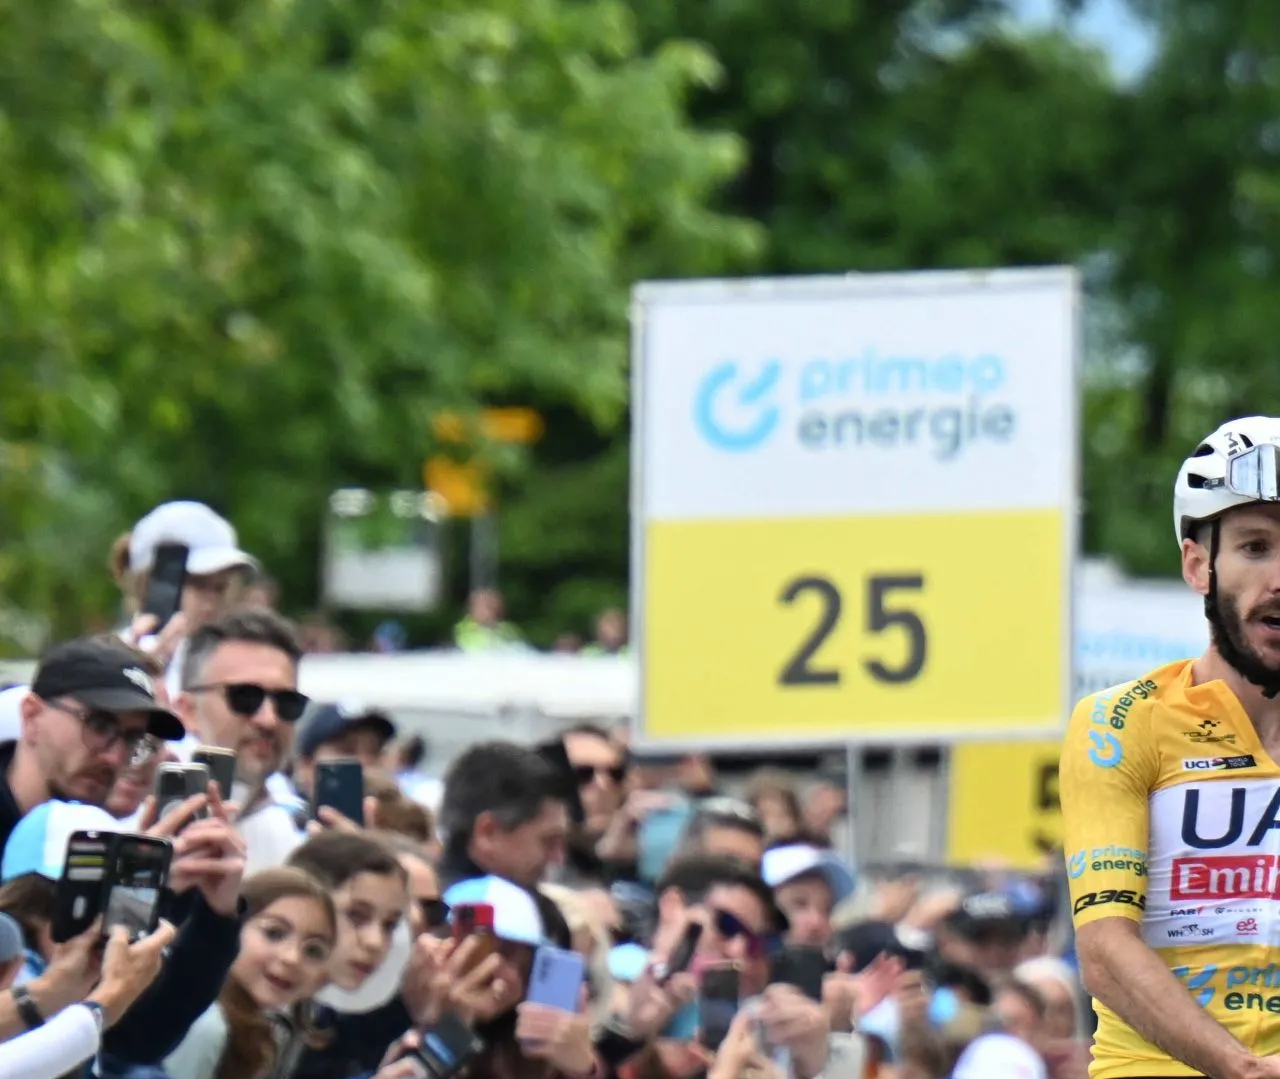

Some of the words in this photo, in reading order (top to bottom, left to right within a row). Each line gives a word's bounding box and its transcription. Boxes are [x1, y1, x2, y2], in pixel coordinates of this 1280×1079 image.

[797, 347, 1005, 404] primeo
[797, 394, 1017, 463] energie
[777, 570, 929, 690] 25
[1109, 679, 1158, 730] energie
[1184, 760, 1211, 770] UCI
